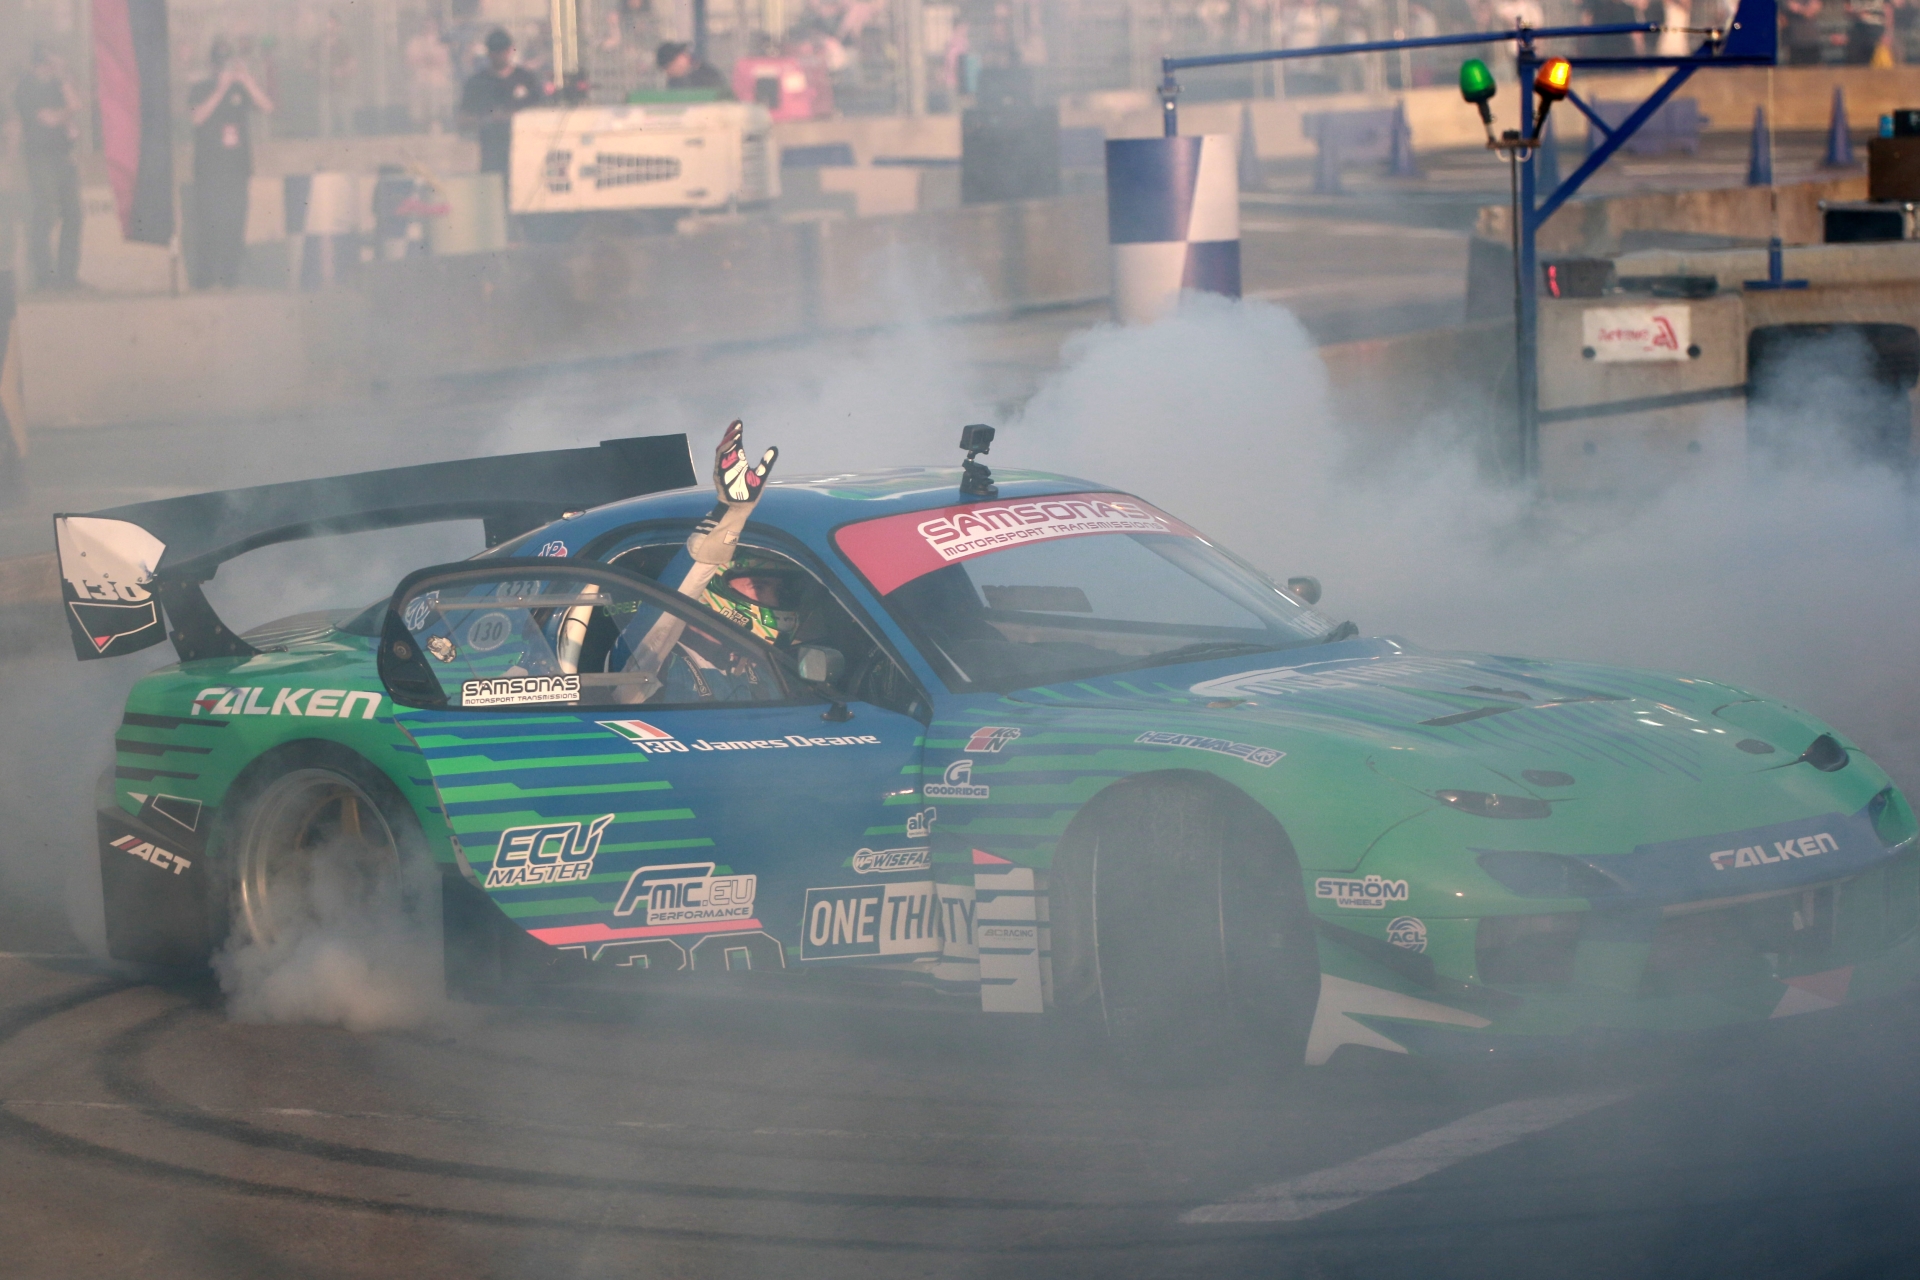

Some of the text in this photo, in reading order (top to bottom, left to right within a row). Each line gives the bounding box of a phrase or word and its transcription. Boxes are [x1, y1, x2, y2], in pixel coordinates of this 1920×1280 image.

[923, 501, 1150, 545] SAMSONAS
[943, 521, 1168, 557] MOTORSPORT TRANSMISSIONS
[71, 580, 152, 601] 130
[603, 600, 643, 617] CORBE
[472, 621, 503, 643] 130
[465, 677, 579, 697] SAMSONAS
[190, 687, 382, 719] FALKEN
[465, 692, 578, 705] MOTORSPORT TRANSMISSIONS
[632, 735, 882, 754] 130 James Deane
[1136, 731, 1257, 757] HEATWAVE
[925, 786, 988, 796] GOODRIDGE
[494, 815, 612, 869] ECU
[1709, 832, 1840, 871] FALKEN
[127, 843, 192, 875] ACT
[873, 852, 931, 867] WISEFAB
[487, 862, 592, 886] MASTER
[1318, 878, 1406, 898] STRÖM
[1339, 898, 1382, 906] WHEELS
[650, 907, 750, 921] PERFORMANCE
[809, 897, 878, 947] ONE
[1390, 931, 1425, 943] ACL
